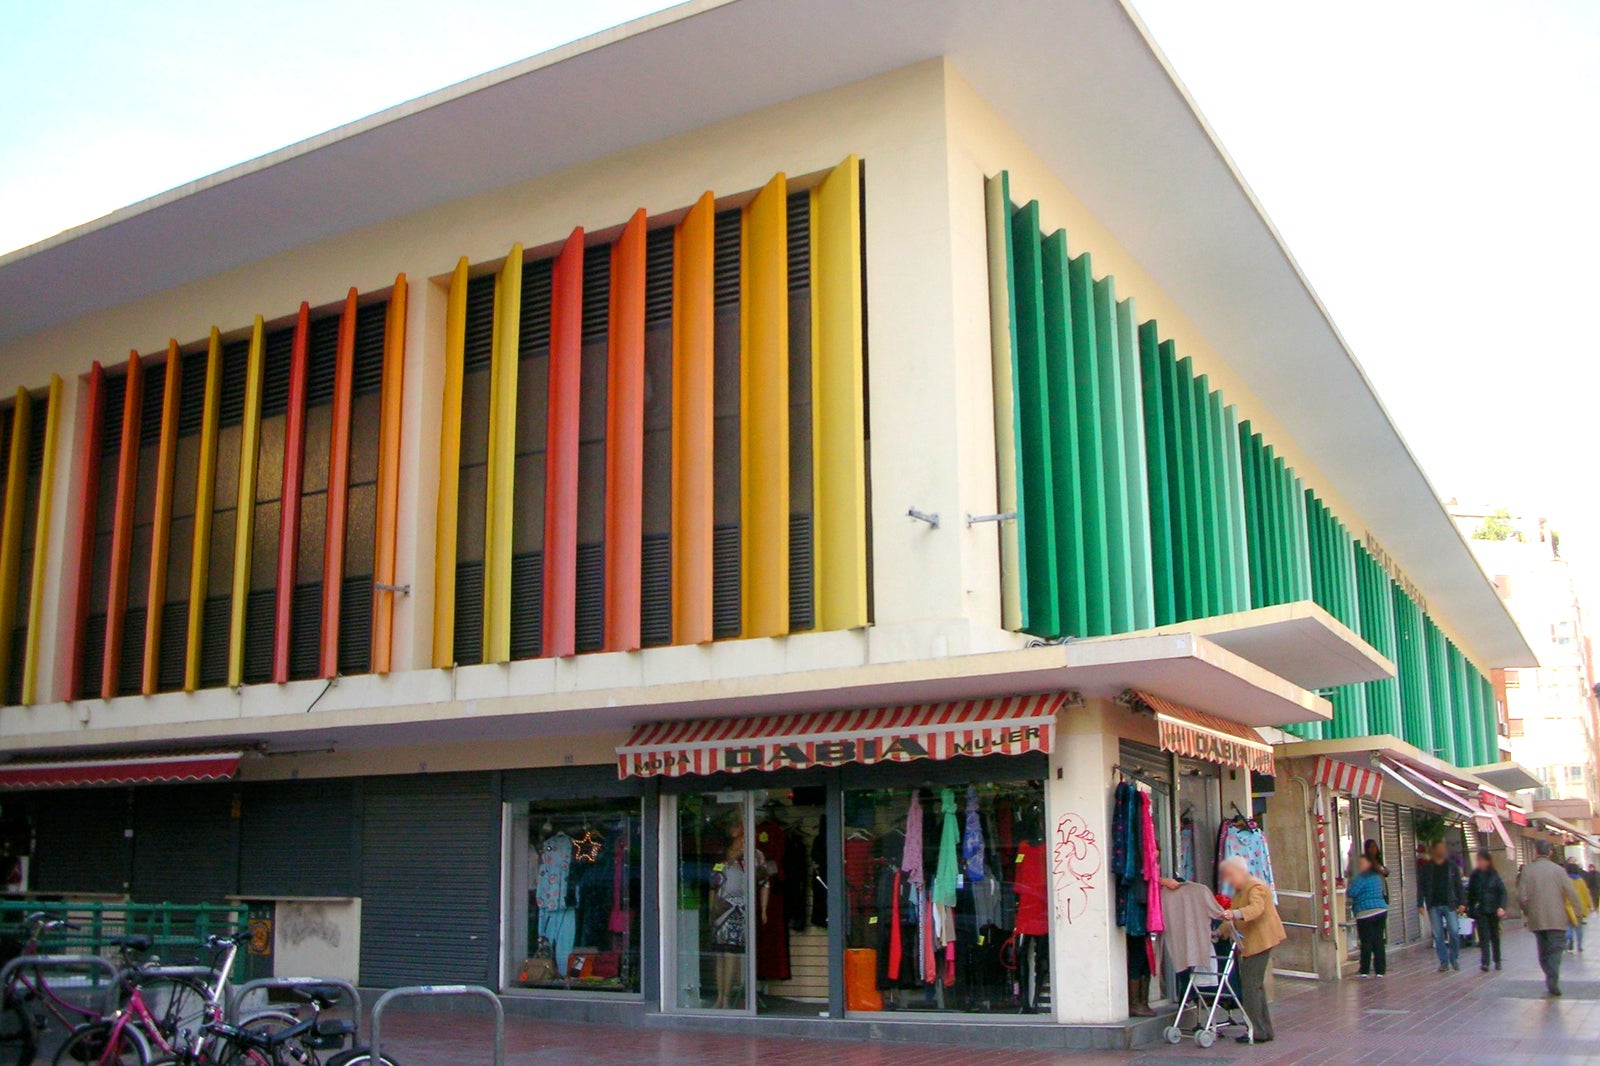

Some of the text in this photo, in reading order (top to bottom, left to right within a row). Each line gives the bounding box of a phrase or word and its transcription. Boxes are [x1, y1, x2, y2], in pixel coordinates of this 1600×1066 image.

[634, 727, 1040, 773] MODA DABIA MUJER
